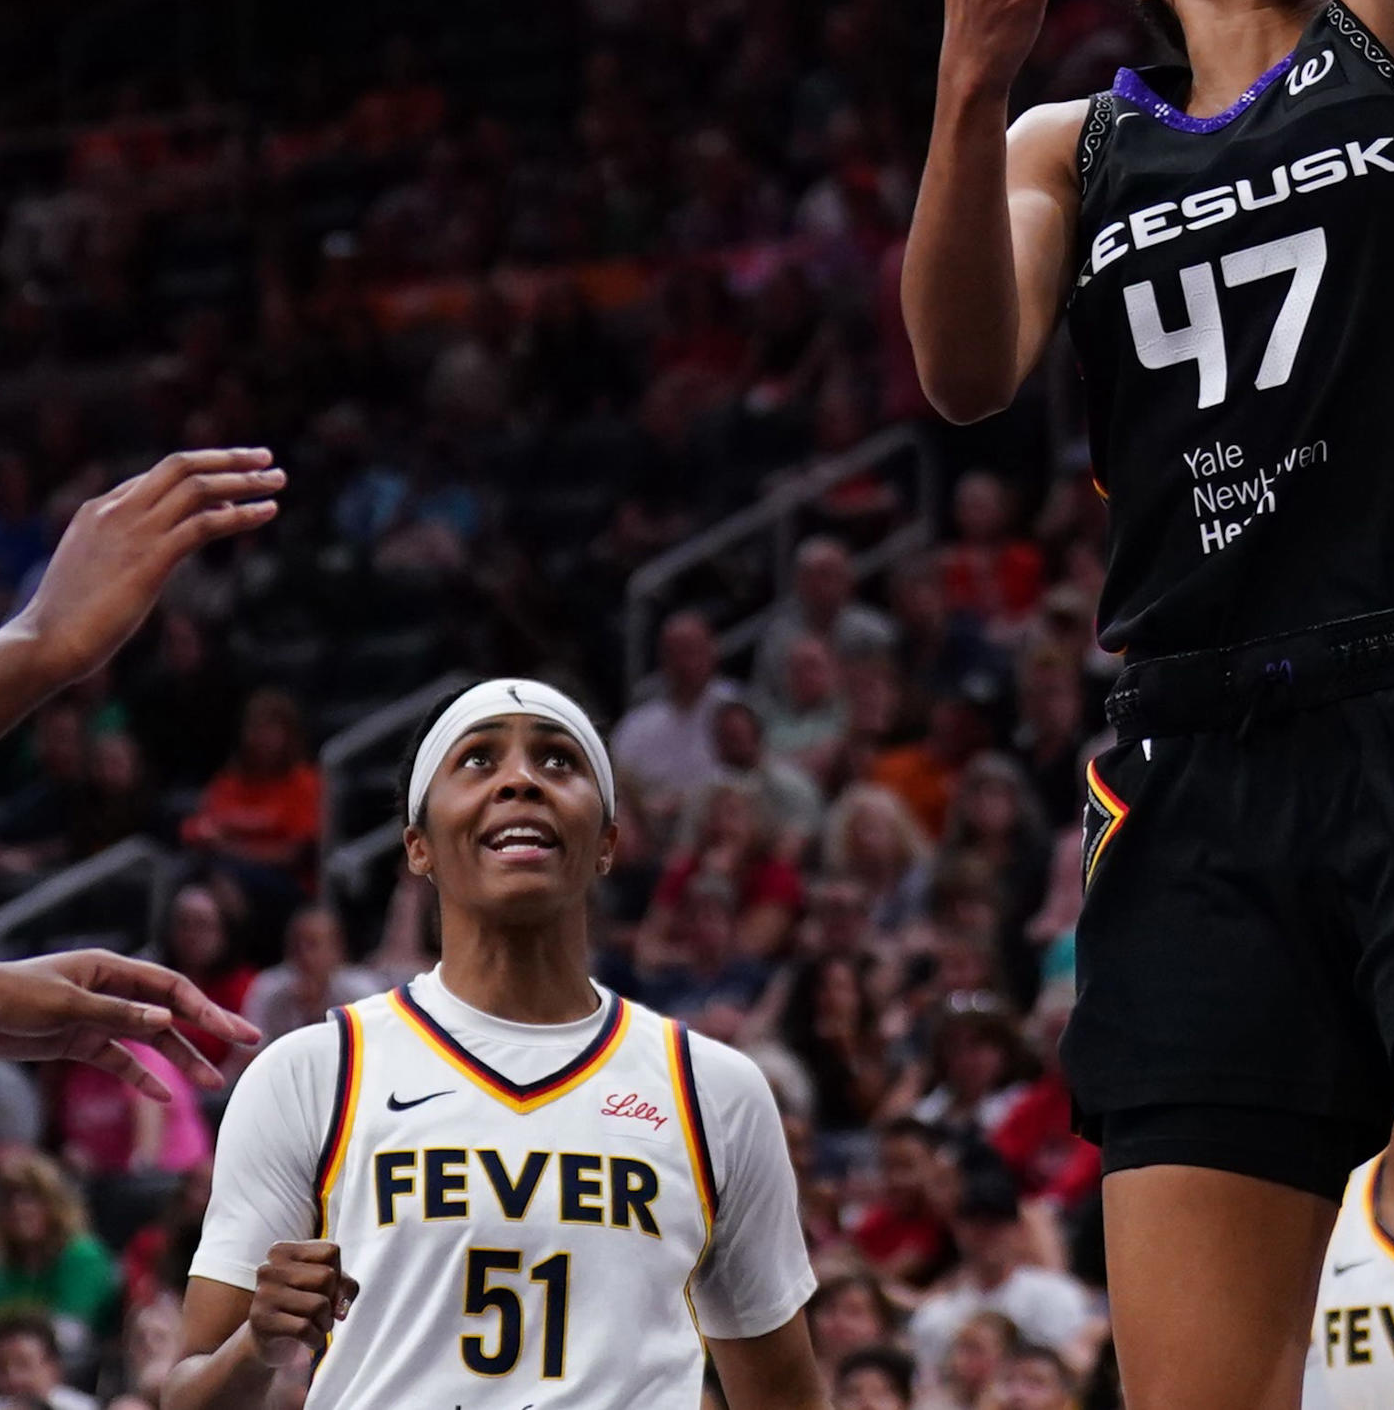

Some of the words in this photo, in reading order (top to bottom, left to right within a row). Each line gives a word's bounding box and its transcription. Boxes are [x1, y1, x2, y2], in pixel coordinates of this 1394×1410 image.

[1123, 227, 1328, 409] 47
[1183, 441, 1244, 479] Yale
[600, 1093, 669, 1132] Lilly
[374, 1147, 662, 1240] FEVER
[459, 1246, 572, 1381] 51
